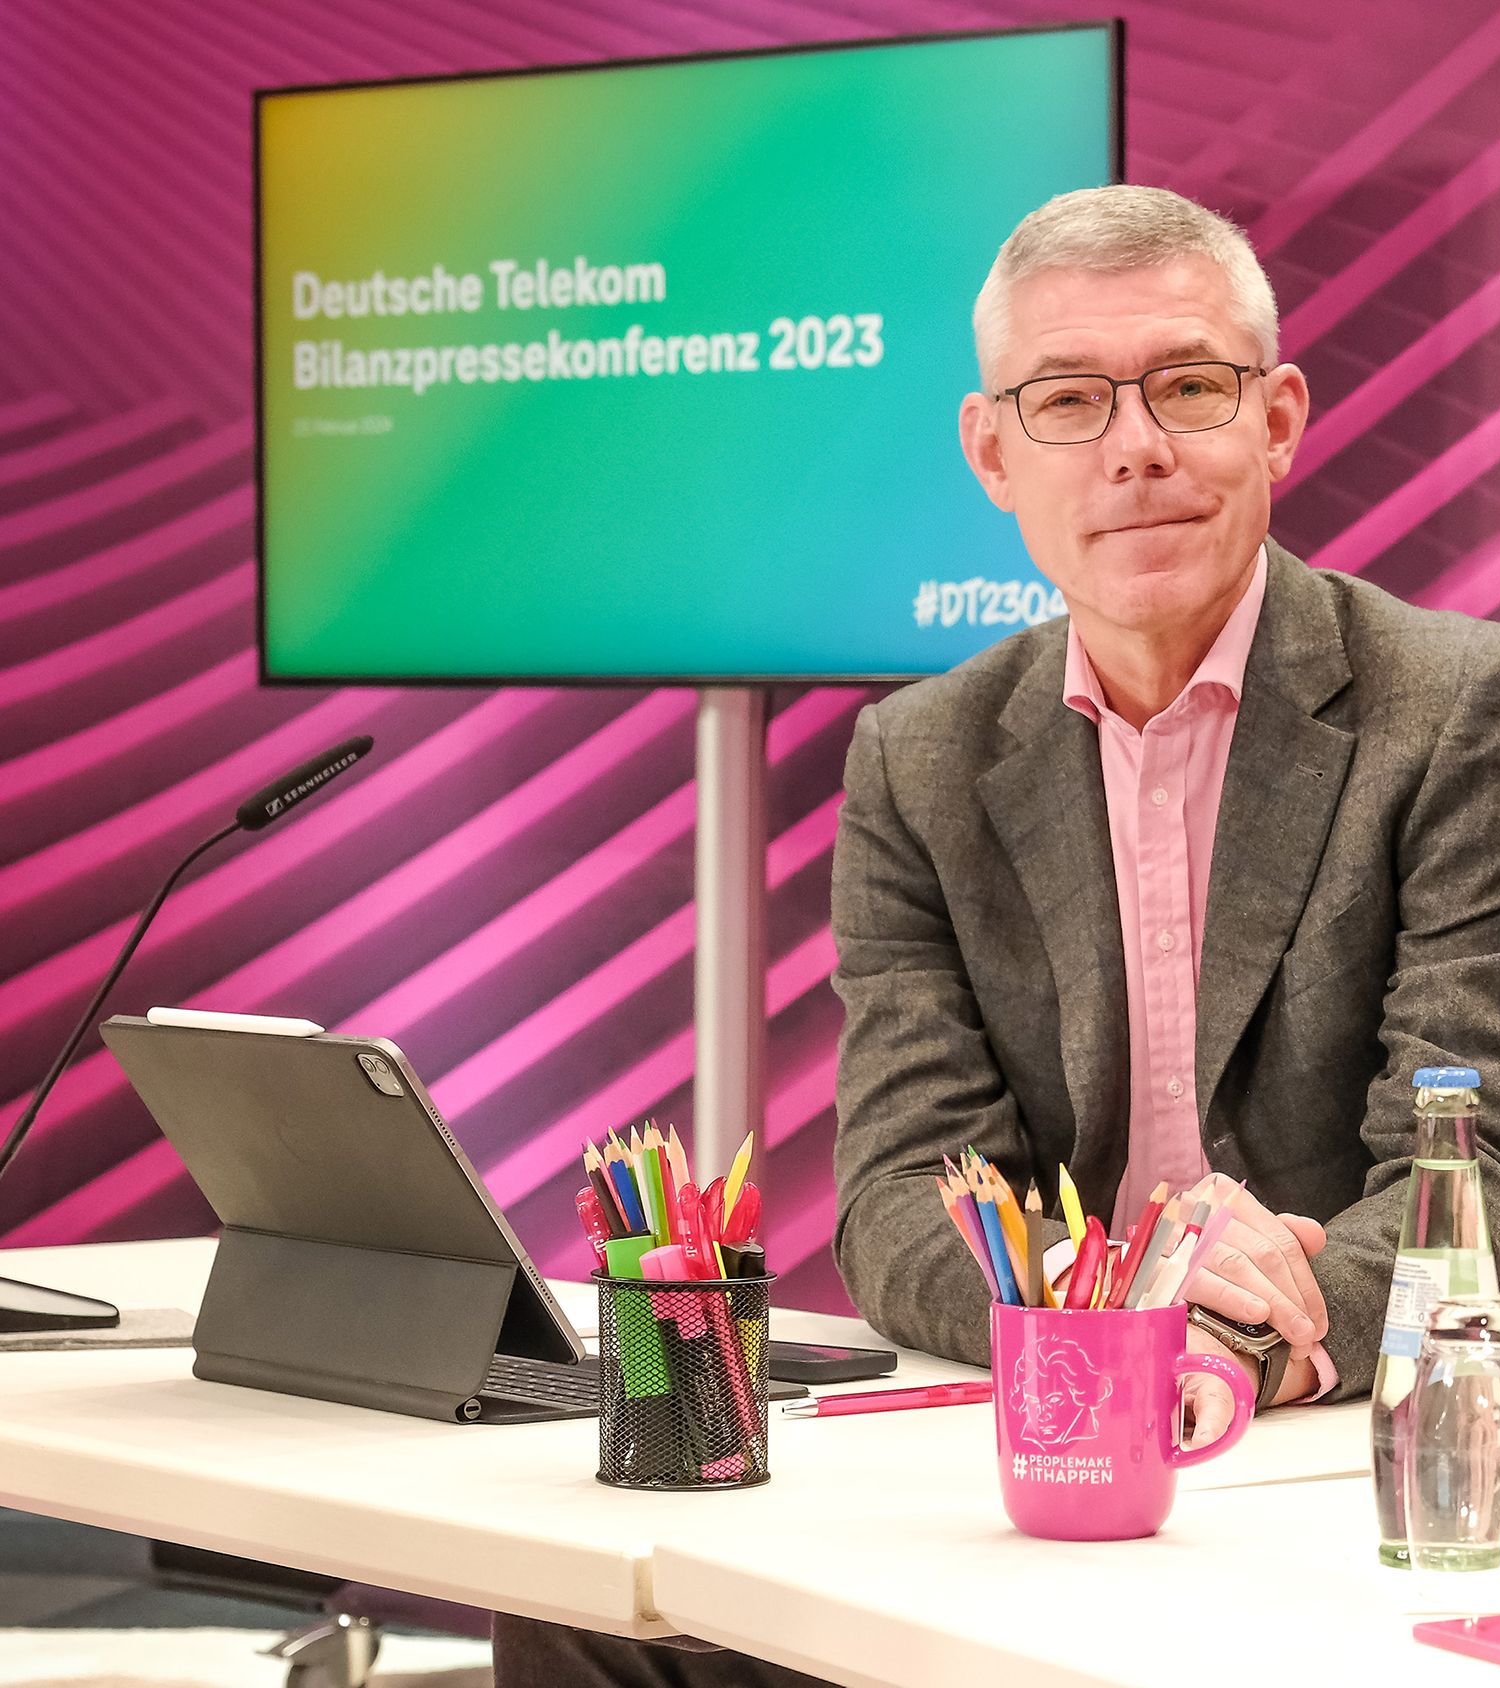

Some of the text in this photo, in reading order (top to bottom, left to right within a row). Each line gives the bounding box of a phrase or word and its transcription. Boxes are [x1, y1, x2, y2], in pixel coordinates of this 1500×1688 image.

[293, 256, 667, 320] Deutsche Telekom
[293, 312, 885, 396] Bilanzpressekonferenz 2023
[1030, 1467, 1113, 1484] ITHAPPEN
